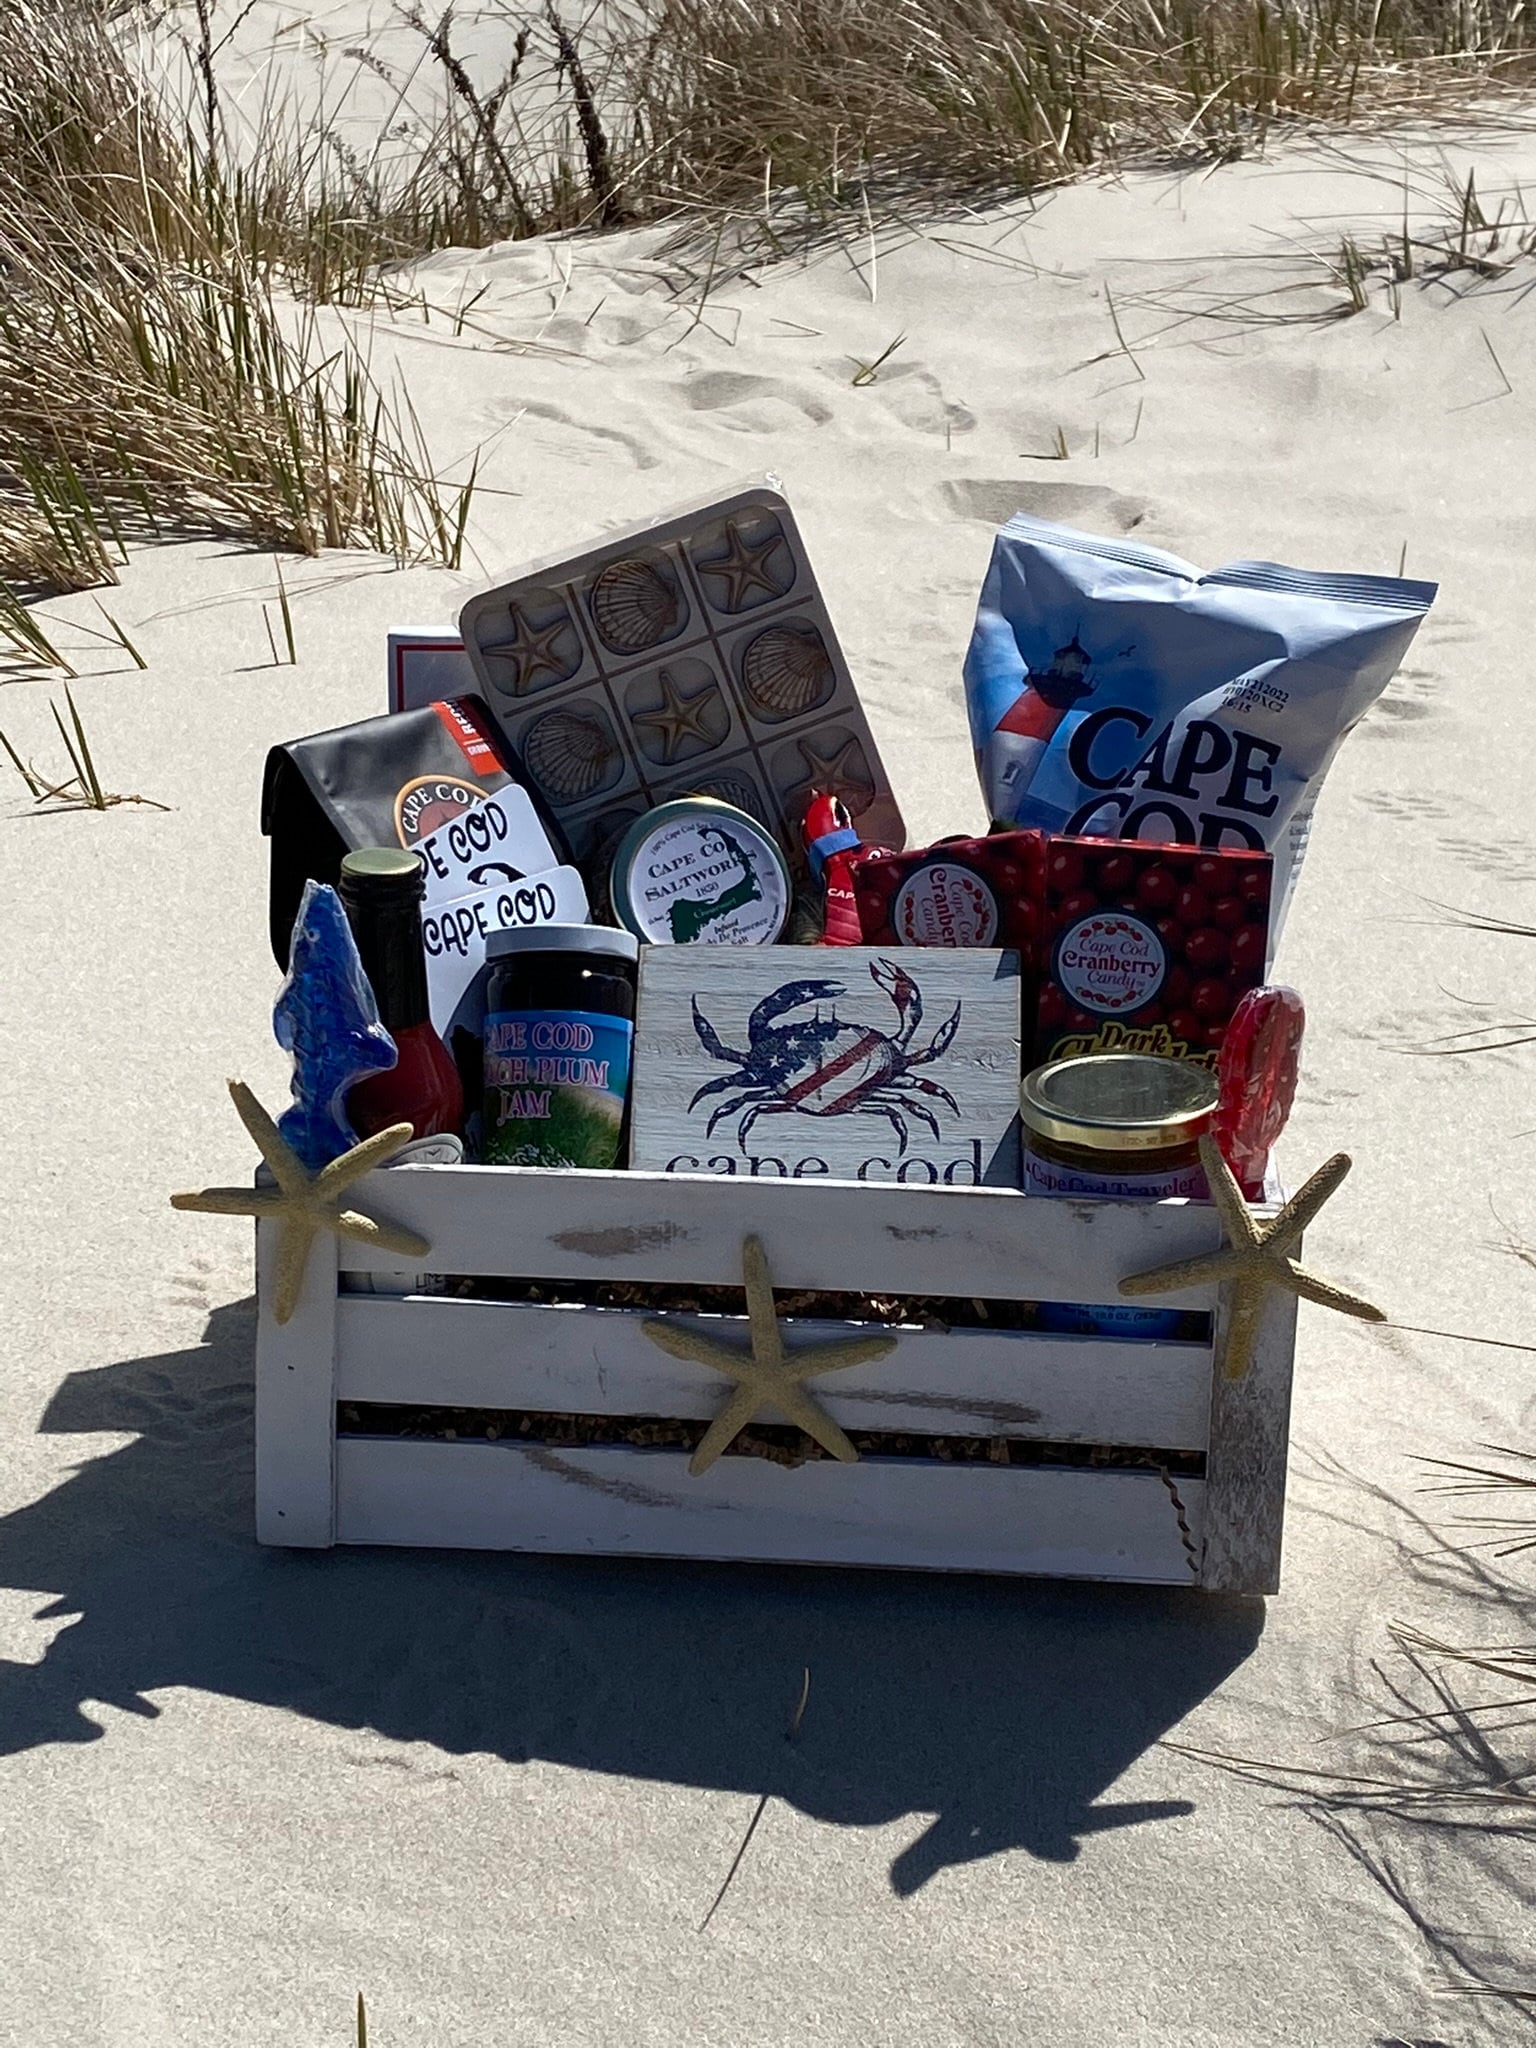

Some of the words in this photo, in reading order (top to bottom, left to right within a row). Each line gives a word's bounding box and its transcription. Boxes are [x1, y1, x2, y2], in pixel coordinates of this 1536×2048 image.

[1067, 706, 1283, 819] CAPE
[402, 787, 433, 834] CAPE
[448, 801, 508, 863] COD
[648, 852, 697, 879] CAPE
[699, 841, 727, 858] CO
[827, 887, 856, 900] CAP
[929, 867, 957, 948] Cranber
[423, 901, 489, 957] CAPE
[497, 883, 556, 928] COD
[1061, 951, 1162, 978] Cranberry
[1079, 938, 1116, 957] Cape
[1119, 940, 1150, 957] Cod
[531, 1021, 594, 1052] COD
[1101, 1022, 1170, 1054] Dark
[533, 1056, 610, 1090] PLUM
[496, 1090, 553, 1127] JAM
[856, 1138, 984, 1186] cod
[1031, 1161, 1068, 1192] Cape
[1068, 1177, 1107, 1194] Cod
[1111, 1176, 1198, 1197] Traveler
